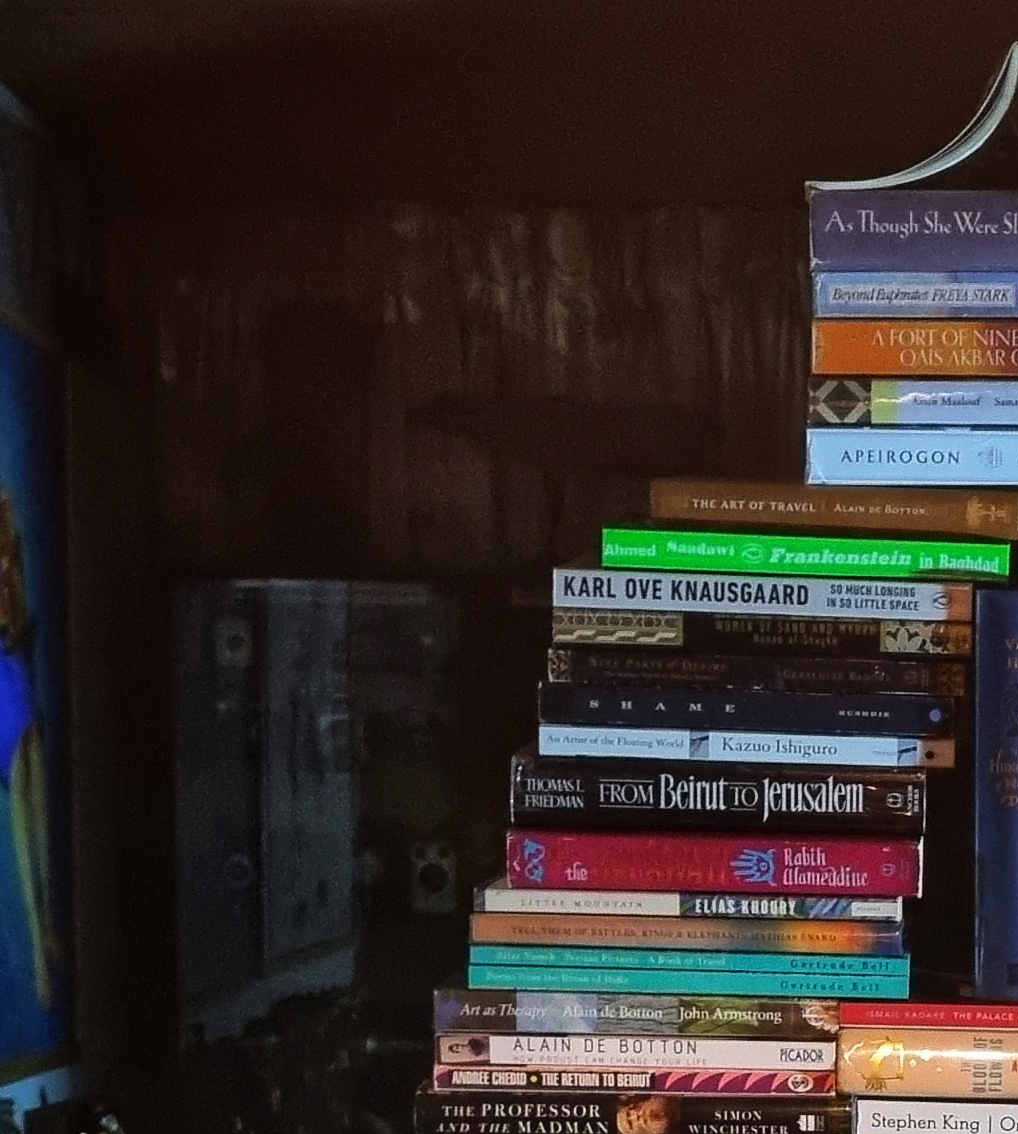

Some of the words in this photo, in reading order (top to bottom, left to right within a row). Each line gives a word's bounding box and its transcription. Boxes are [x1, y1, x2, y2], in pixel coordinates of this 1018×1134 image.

[825, 209, 853, 233] As
[859, 209, 919, 238] Though
[924, 210, 952, 233] She
[954, 211, 998, 233] Were
[841, 449, 961, 464] APEIROGON
[564, 577, 616, 597] KARL
[625, 578, 662, 600] OVE
[671, 580, 808, 606] KNAUSGAARD
[831, 585, 842, 596] SO
[845, 586, 871, 597] MUCH
[875, 586, 916, 597] LONGING
[827, 597, 836, 608] IN
[839, 598, 851, 609] SO
[854, 598, 885, 610] LITTLE
[889, 600, 920, 611] SPACE
[722, 738, 771, 753] Kazuo
[775, 739, 837, 759] Ishiguro
[600, 783, 653, 803] FROM
[659, 775, 729, 810] Beirut
[731, 786, 757, 804] TO
[763, 777, 863, 822] Jerusalem
[514, 1037, 572, 1053] ALAIN
[584, 1039, 605, 1053] DE
[620, 1039, 697, 1055] BOTTON
[780, 1048, 823, 1063] PICADOR
[442, 1105, 475, 1118] THE
[482, 1104, 601, 1119] PROFESSOR
[715, 1110, 763, 1121] SIMON
[436, 1122, 469, 1134] AND
[479, 1122, 510, 1134] THE
[518, 1121, 609, 1134] MADMAN
[871, 1112, 937, 1134] Stephen
